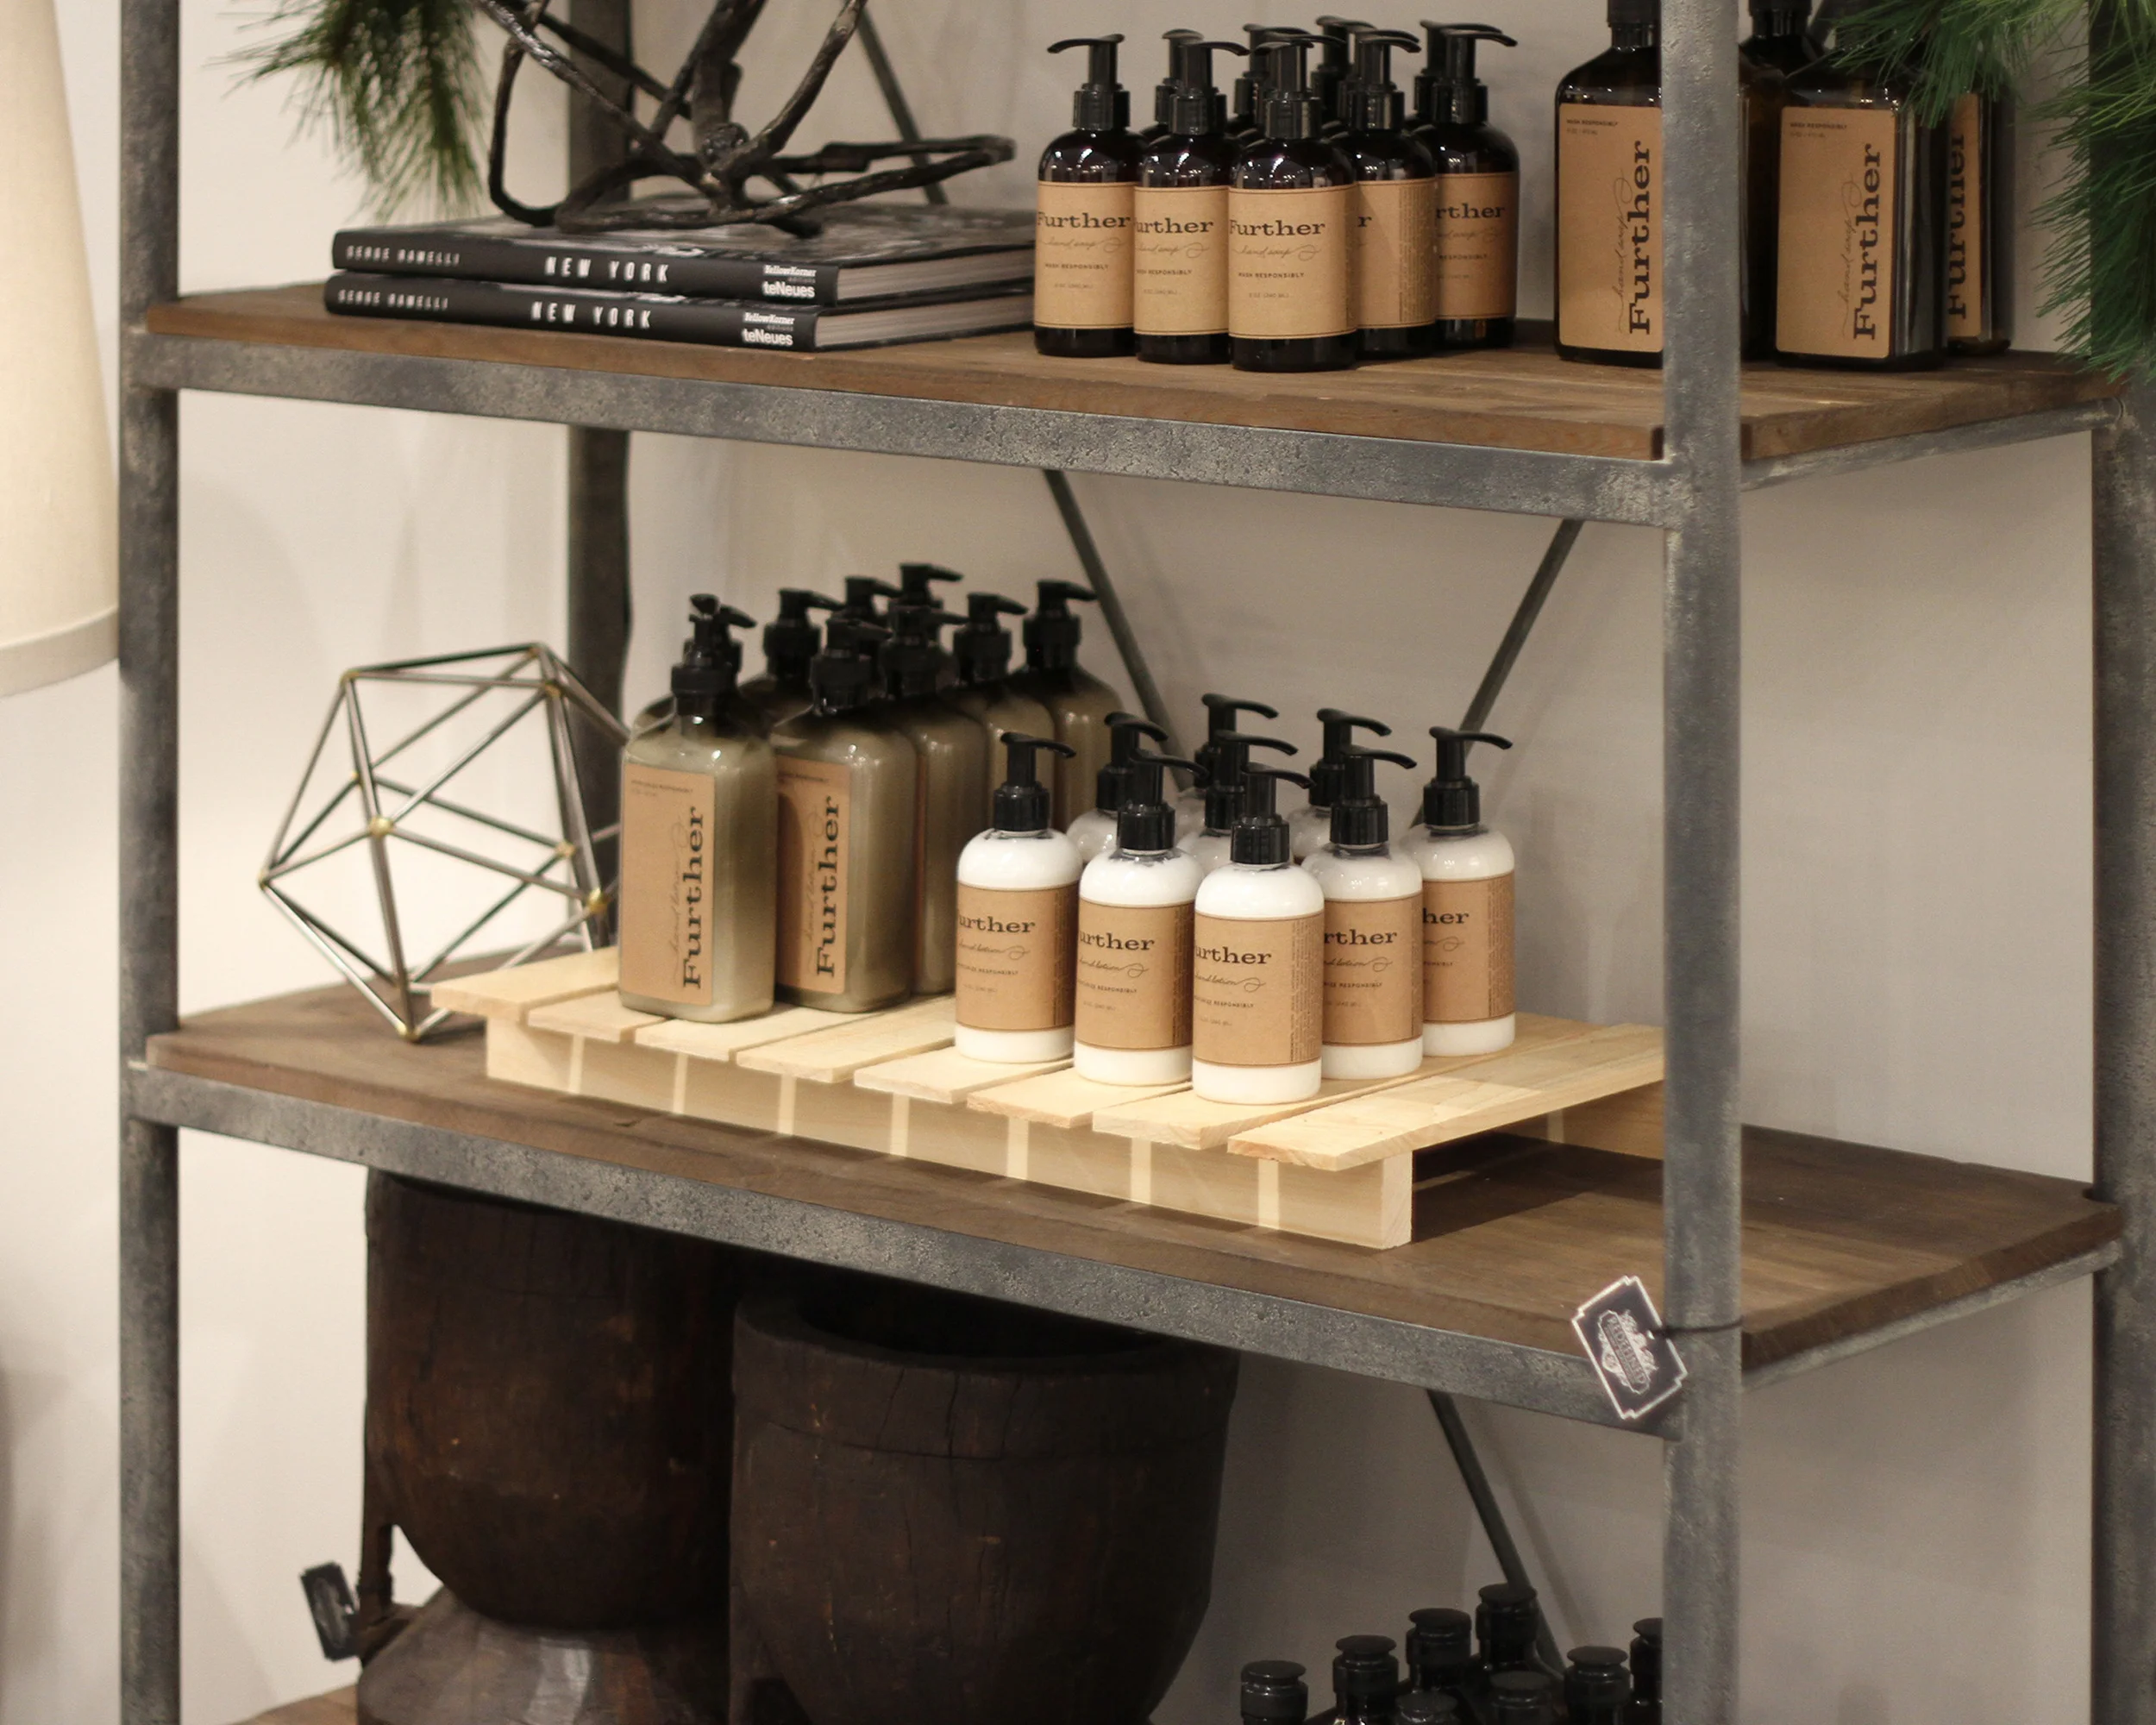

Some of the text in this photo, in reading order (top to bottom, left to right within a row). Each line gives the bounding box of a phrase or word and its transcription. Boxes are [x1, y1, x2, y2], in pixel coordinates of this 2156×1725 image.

[1435, 202, 1506, 219] rther
[1037, 211, 1131, 229] Further
[1136, 217, 1214, 234] urther
[1229, 219, 1326, 236] Further
[1627, 141, 1650, 335] Further
[1853, 143, 1880, 341] Further
[545, 256, 668, 284] NEW YORK
[762, 281, 816, 298] teNeues
[530, 302, 651, 329] NEW YORK
[743, 328, 793, 347] teNeues
[817, 795, 840, 977] Further
[682, 806, 705, 989] Further
[958, 916, 1036, 932] urther
[1080, 932, 1156, 950] urther
[1324, 929, 1397, 945] rther
[1195, 946, 1272, 964] urther
